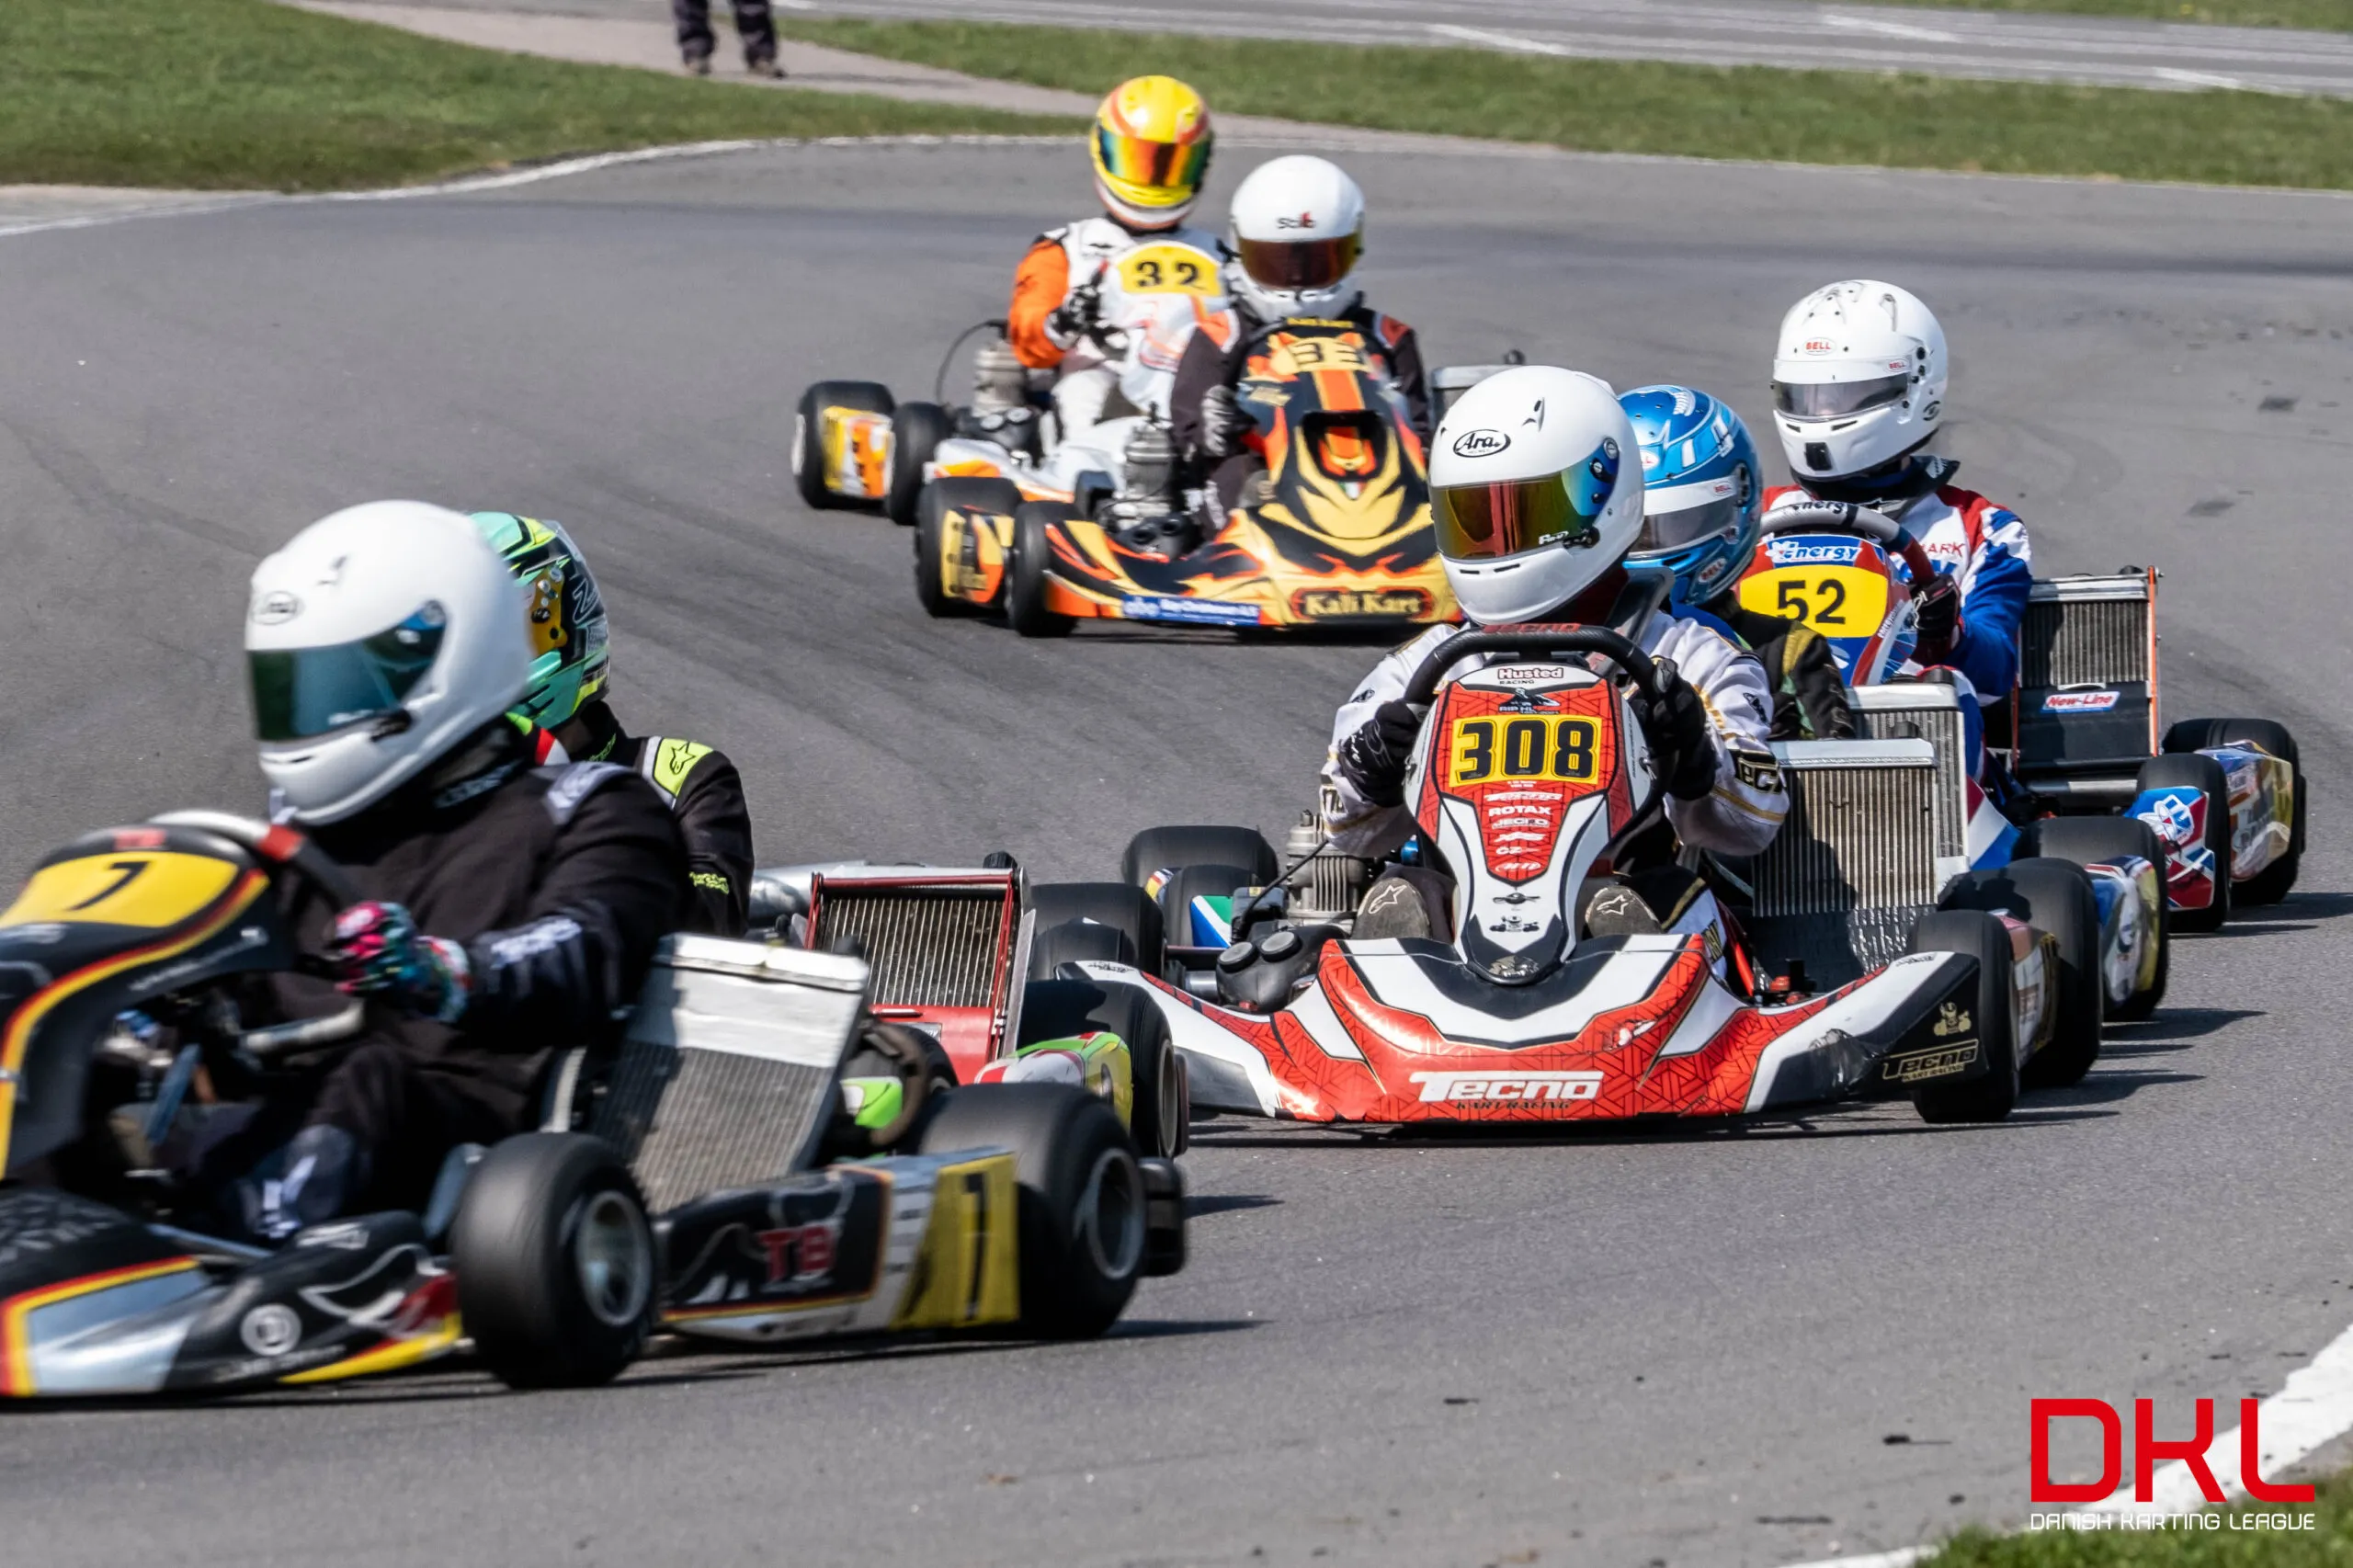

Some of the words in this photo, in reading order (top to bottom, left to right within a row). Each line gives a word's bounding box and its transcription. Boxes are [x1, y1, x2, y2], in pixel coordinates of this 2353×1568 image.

[1136, 261, 1205, 290] 32
[1805, 341, 1831, 350] BELL
[1781, 542, 1859, 561] Energy
[1777, 579, 1847, 624] 52
[1497, 667, 1564, 679] Husted
[1458, 719, 1596, 781] 308
[1488, 805, 1552, 817] ROTAX
[1882, 1039, 1979, 1080] Tecno
[1410, 1071, 1604, 1102] Tecno
[757, 1224, 835, 1284] TB
